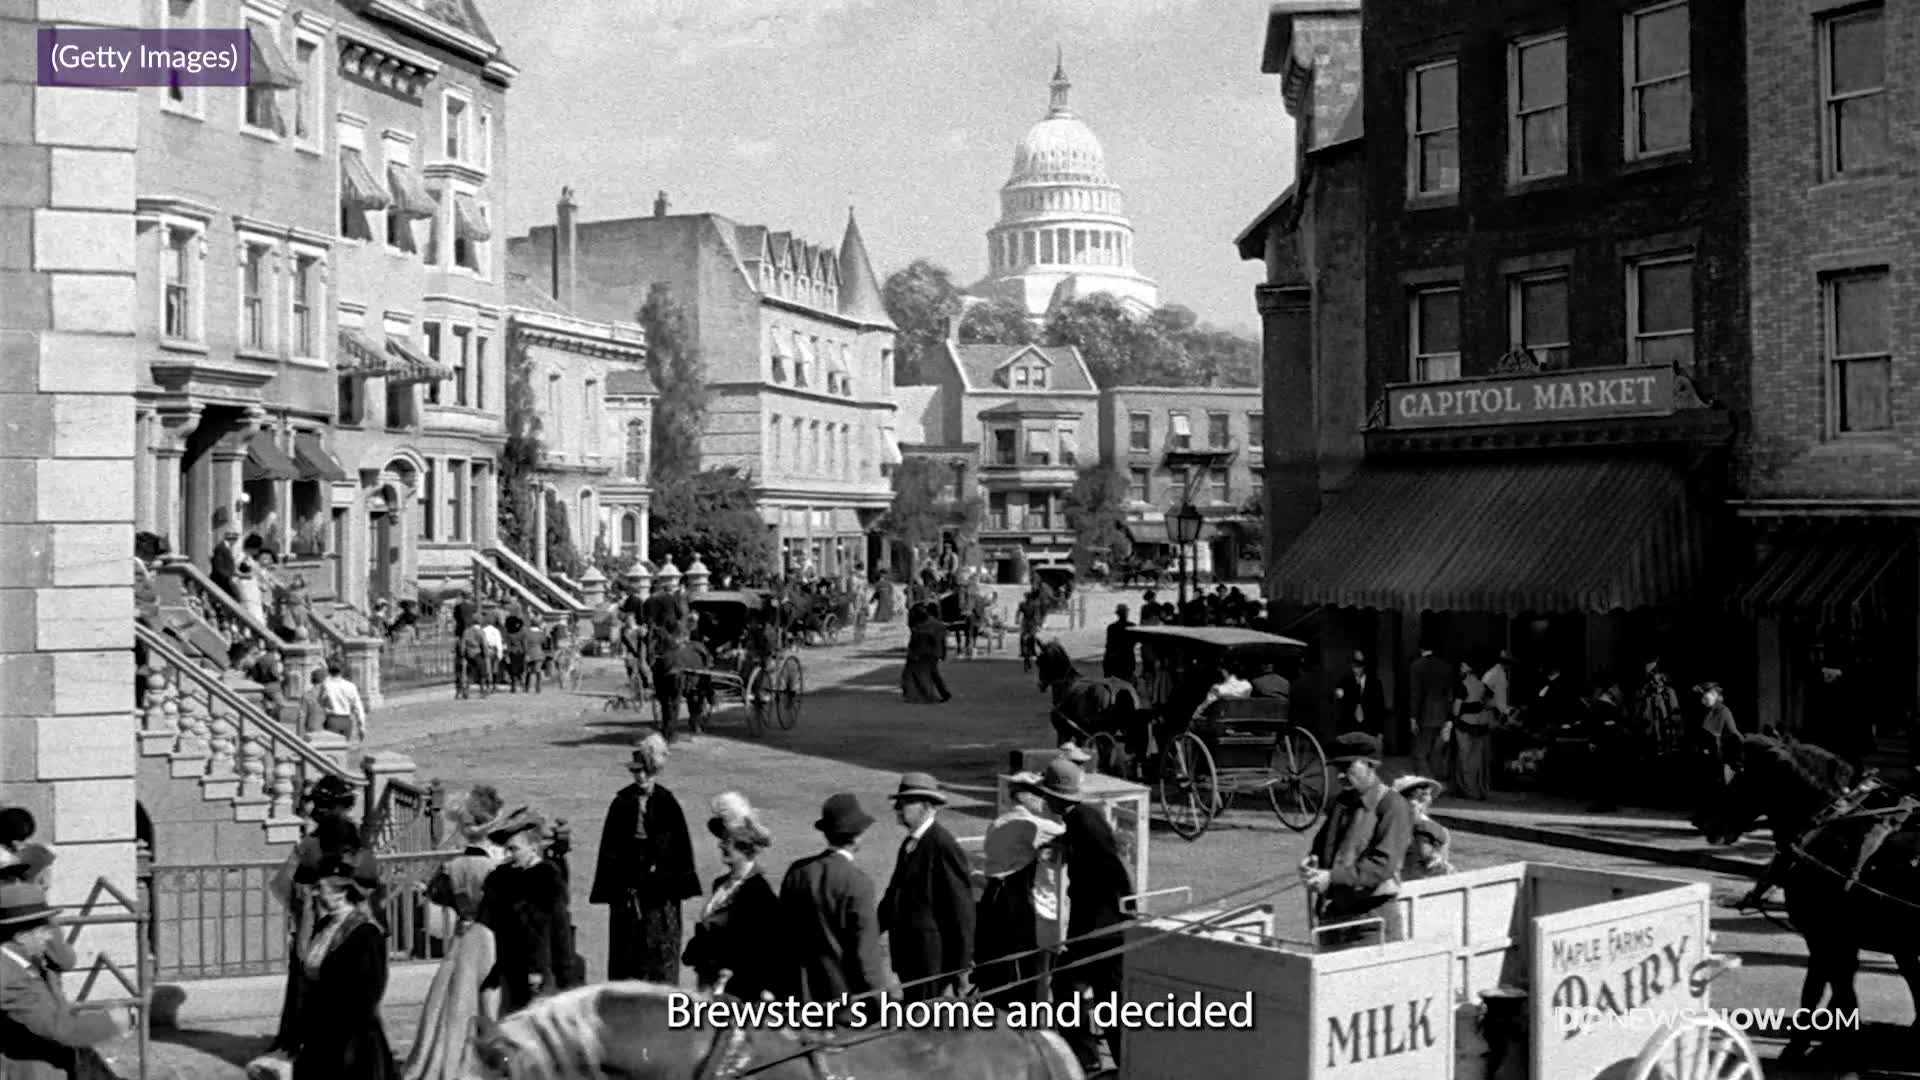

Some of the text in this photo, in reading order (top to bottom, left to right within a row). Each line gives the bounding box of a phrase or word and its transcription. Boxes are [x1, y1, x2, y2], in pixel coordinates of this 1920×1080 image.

[1400, 377, 1656, 418] CAPITOL MARKET
[1552, 926, 1655, 970] MAPLE FARMS
[1552, 935, 1689, 1040] DAIRY
[1327, 997, 1437, 1068] MILK
